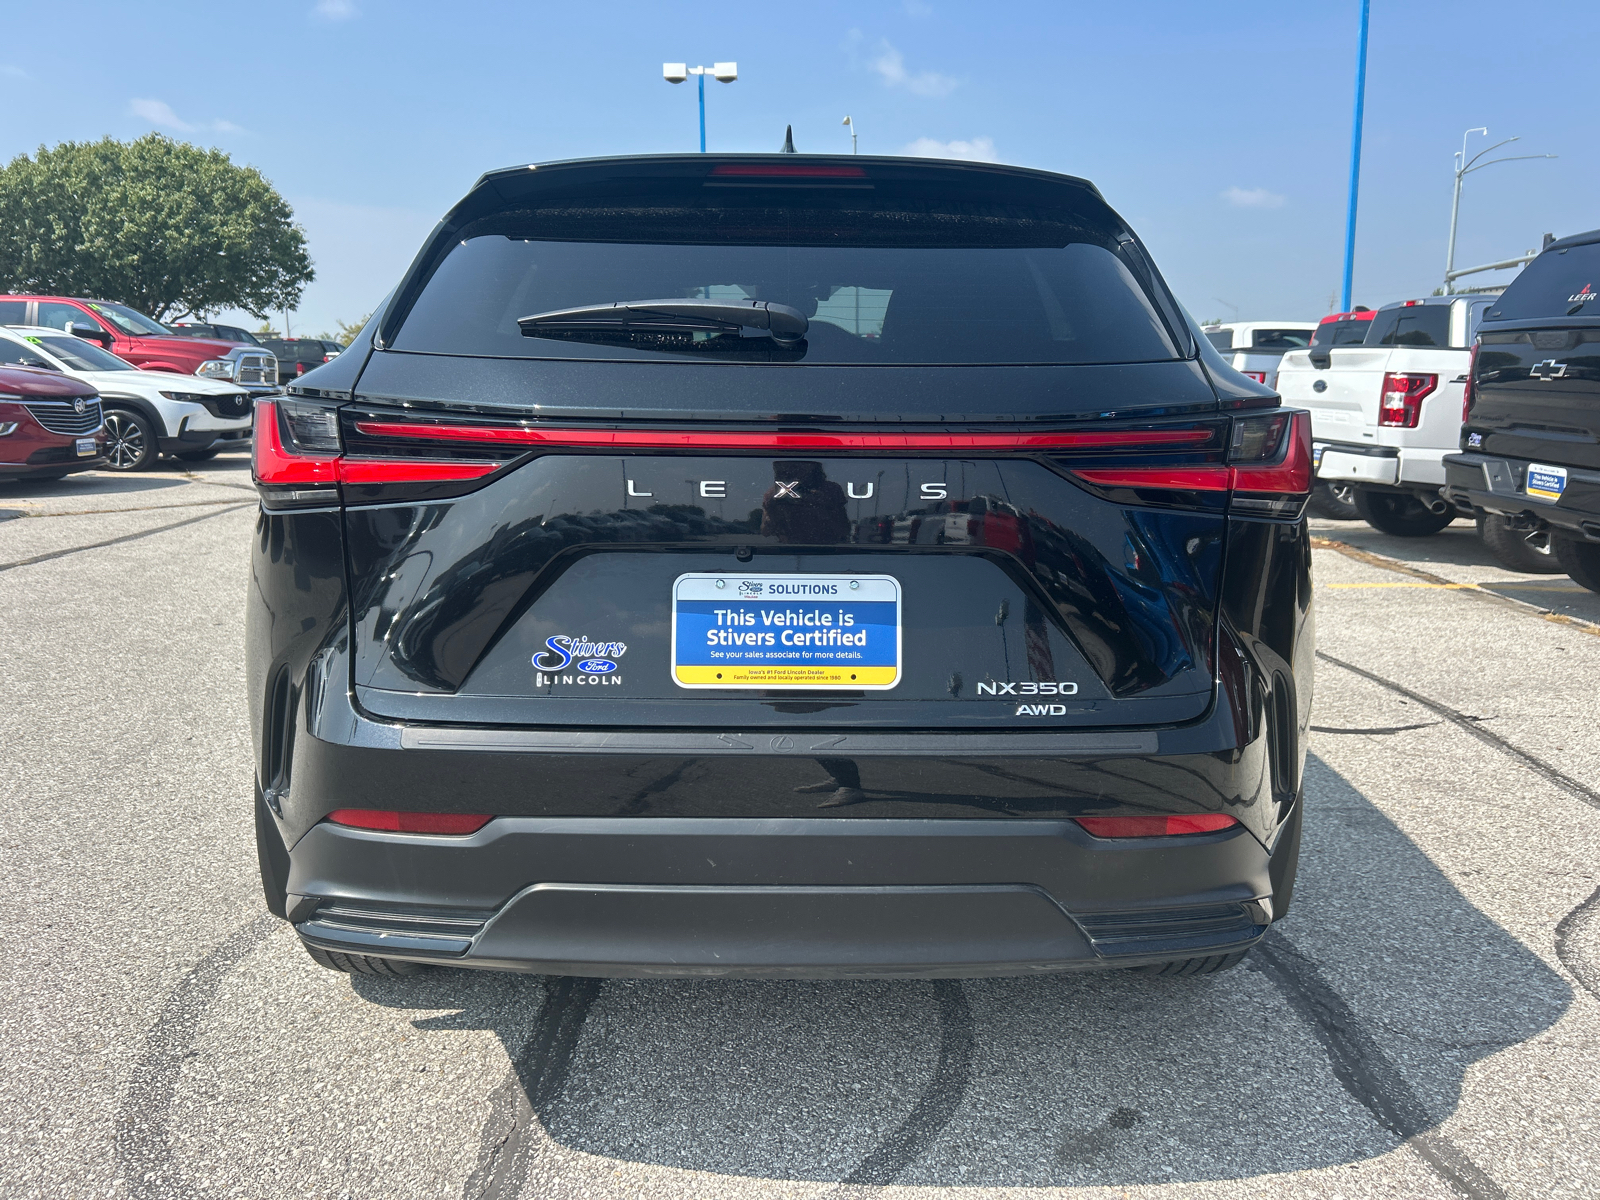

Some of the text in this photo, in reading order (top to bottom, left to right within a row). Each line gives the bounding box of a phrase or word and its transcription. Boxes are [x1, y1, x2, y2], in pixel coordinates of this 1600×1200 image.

[1567, 293, 1598, 302] LEER
[627, 479, 948, 499] LEXUS
[768, 584, 838, 595] SOLUTIONS
[713, 609, 855, 627] This Vehicle is
[706, 628, 867, 646] Stivers Certified
[532, 635, 627, 671] Stivers
[710, 650, 724, 658] See
[726, 651, 743, 660] your
[765, 651, 800, 659] associate
[802, 651, 813, 659] for
[814, 651, 834, 659] more
[835, 651, 863, 659] details.
[584, 660, 610, 671] Ford
[543, 675, 622, 685] LINCOLN
[1015, 704, 1067, 716] AWD
